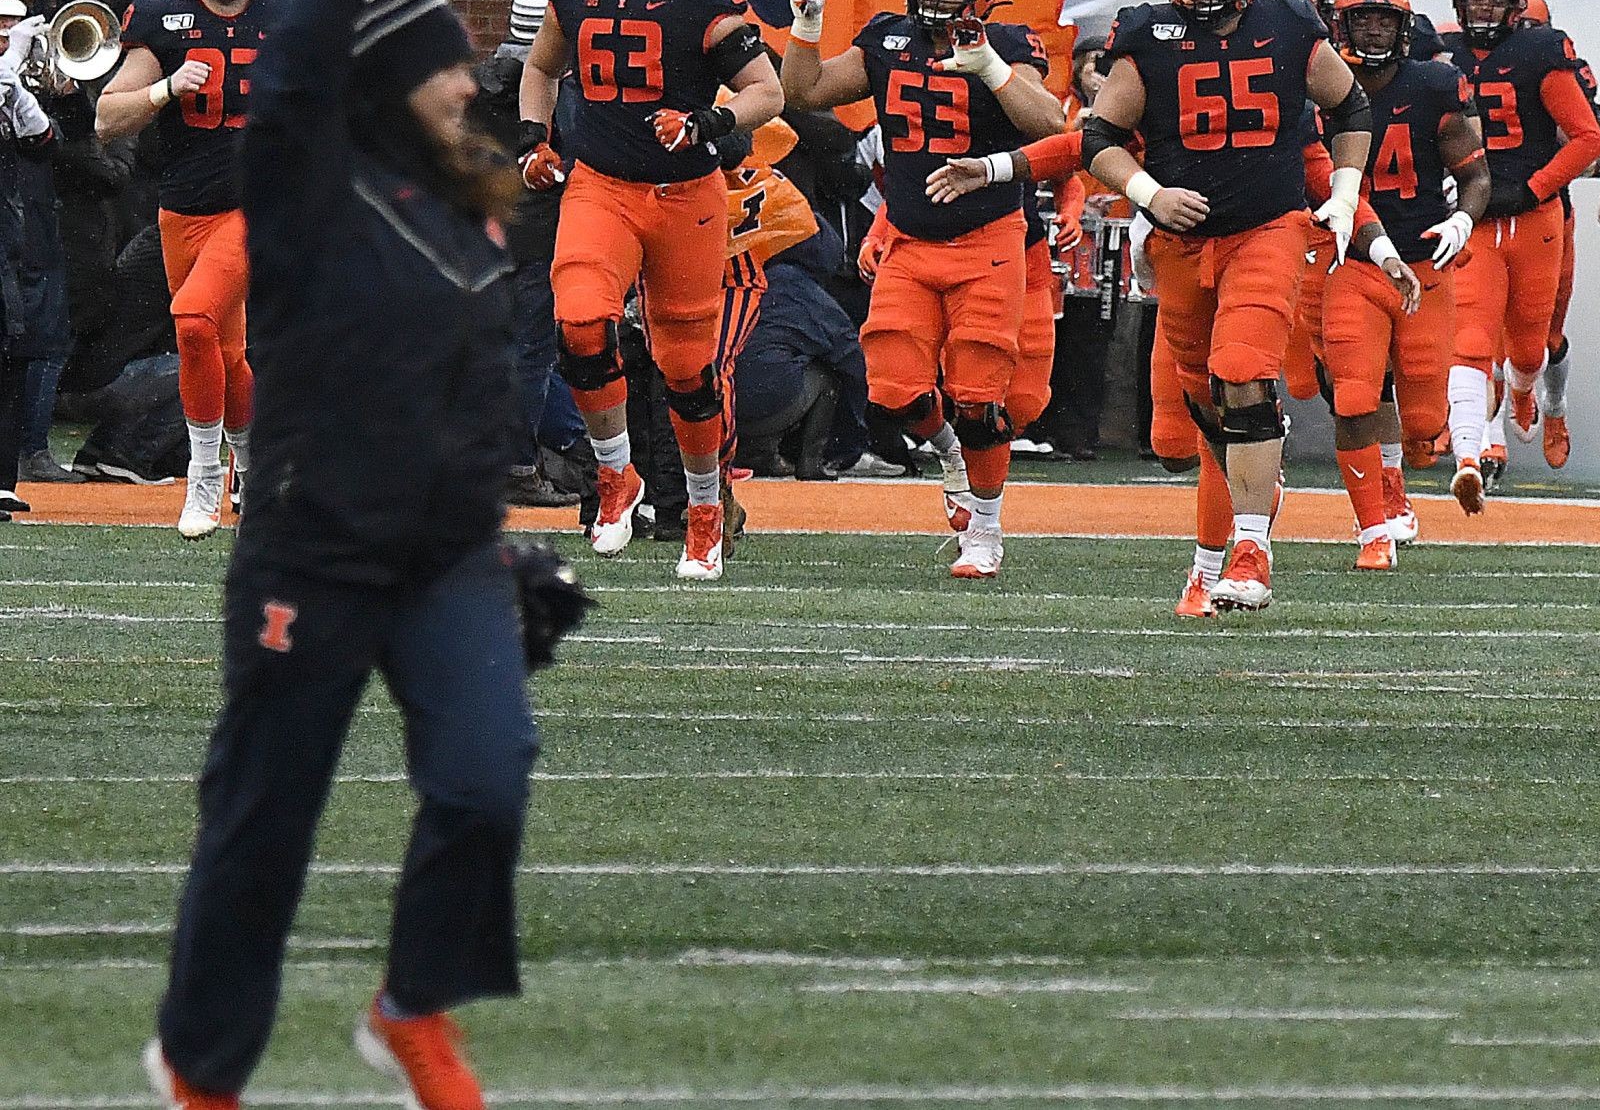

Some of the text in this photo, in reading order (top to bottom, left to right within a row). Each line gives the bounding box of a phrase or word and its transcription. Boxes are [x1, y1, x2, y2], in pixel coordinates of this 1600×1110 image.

[578, 17, 664, 103] 63
[885, 68, 972, 154] 53
[1177, 56, 1281, 151] 65
[1479, 81, 1524, 151] 3
[731, 186, 767, 239] I
